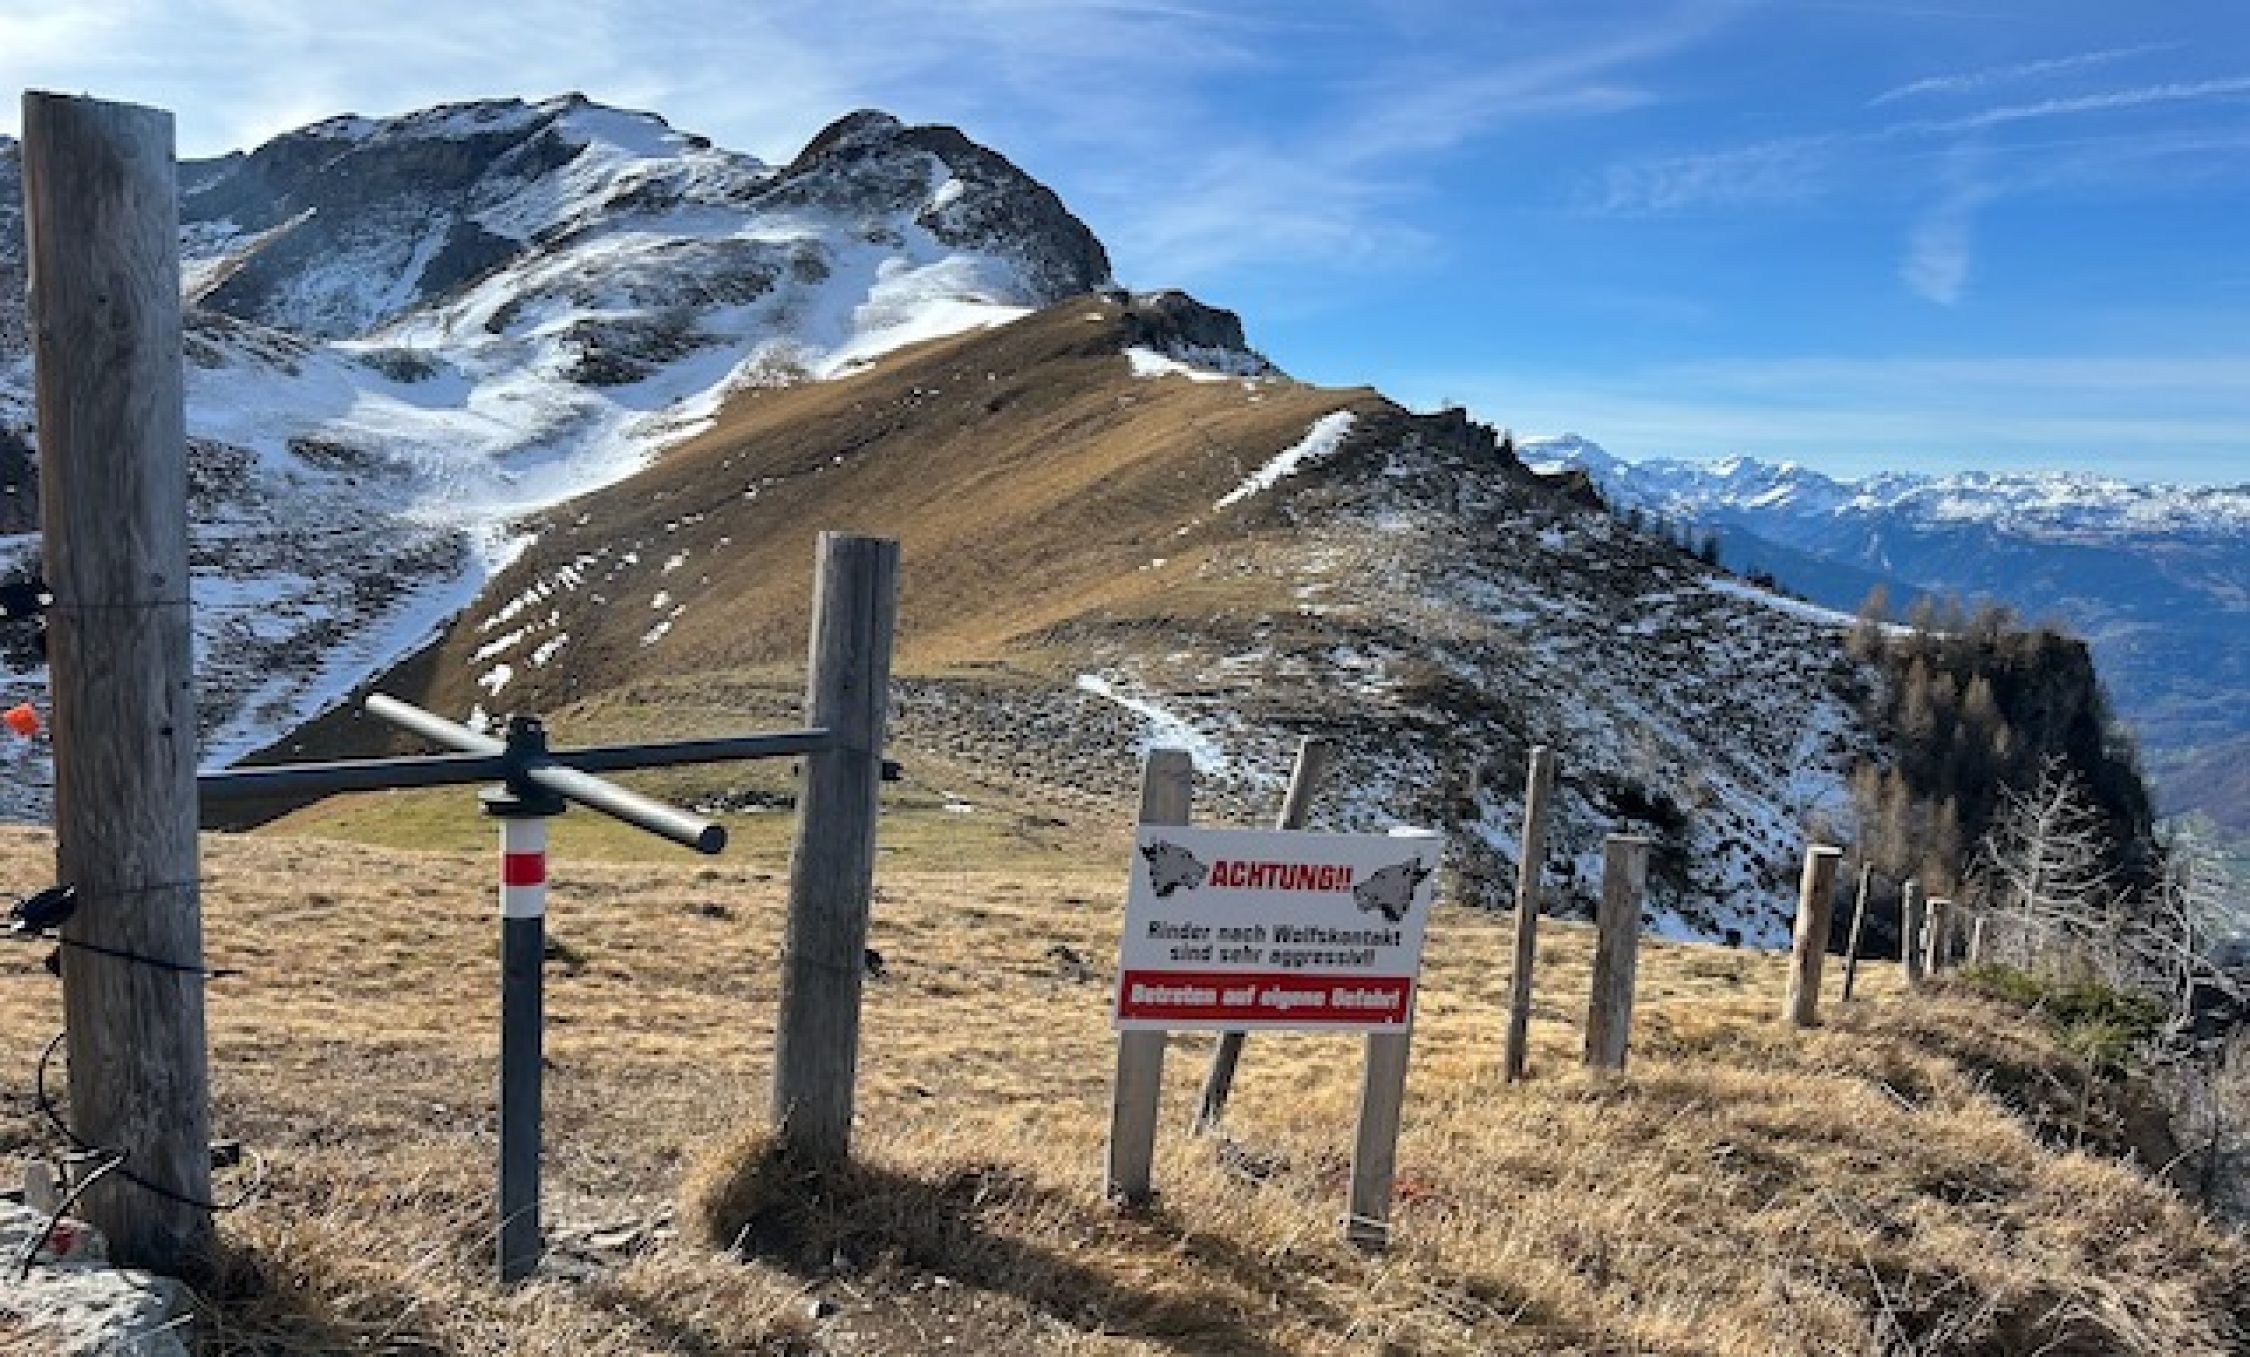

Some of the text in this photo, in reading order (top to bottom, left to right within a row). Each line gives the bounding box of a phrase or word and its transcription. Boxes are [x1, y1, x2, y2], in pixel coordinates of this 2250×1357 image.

[1209, 861, 1353, 892] ACHTUNG!!
[1147, 920, 1401, 946] Rinder nach Wolfskontakt
[1170, 943, 1213, 962] sind
[1219, 945, 1263, 963] sehr
[1222, 985, 1257, 1005] auf
[1259, 987, 1326, 1010] eigene
